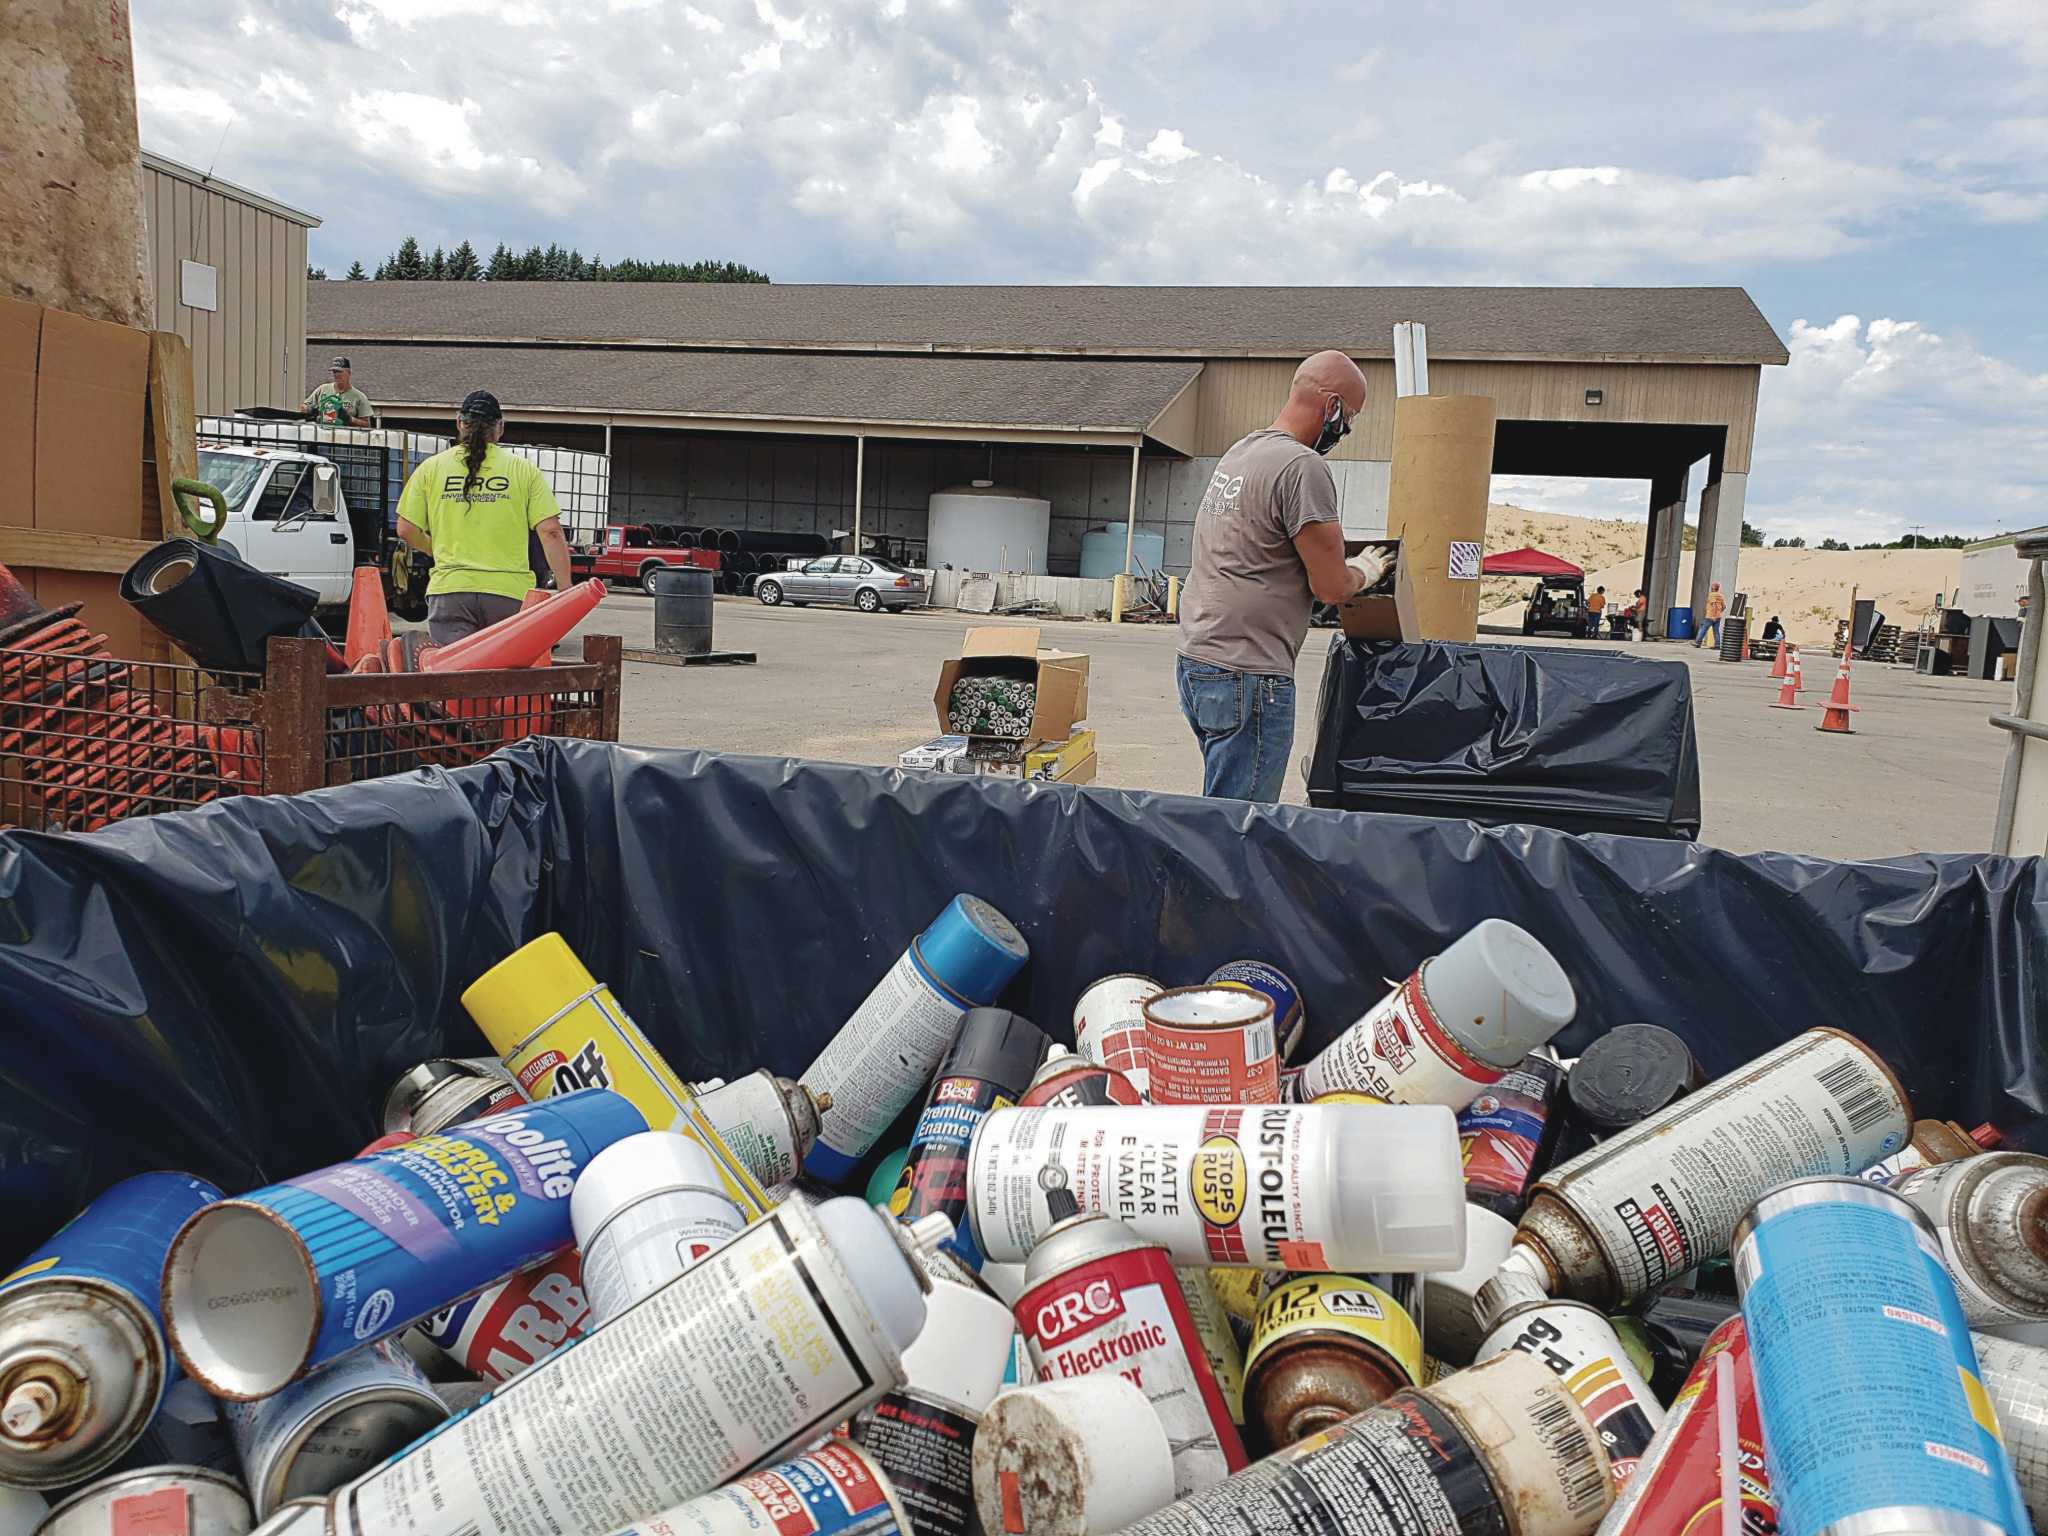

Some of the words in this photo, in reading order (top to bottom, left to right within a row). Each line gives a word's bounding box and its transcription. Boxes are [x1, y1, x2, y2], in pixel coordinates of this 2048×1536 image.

[1189, 1041, 1207, 1052] NET
[1353, 1024, 1410, 1105] ANDABL
[1374, 1020, 1404, 1069] ARMOR
[1383, 1019, 1407, 1058] IRON
[402, 1143, 501, 1228] HOLSTERY
[494, 1193, 518, 1216] &
[1202, 1152, 1219, 1210] RUST
[1217, 1150, 1237, 1215] STOPS
[1619, 1202, 1664, 1287] SOMETHING
[1645, 1211, 1683, 1263] BETTER!
[1036, 1279, 1117, 1341] CRC
[1333, 1293, 1376, 1308] TV
[1056, 1319, 1167, 1379] Electronic
[740, 1472, 791, 1523] DANG
